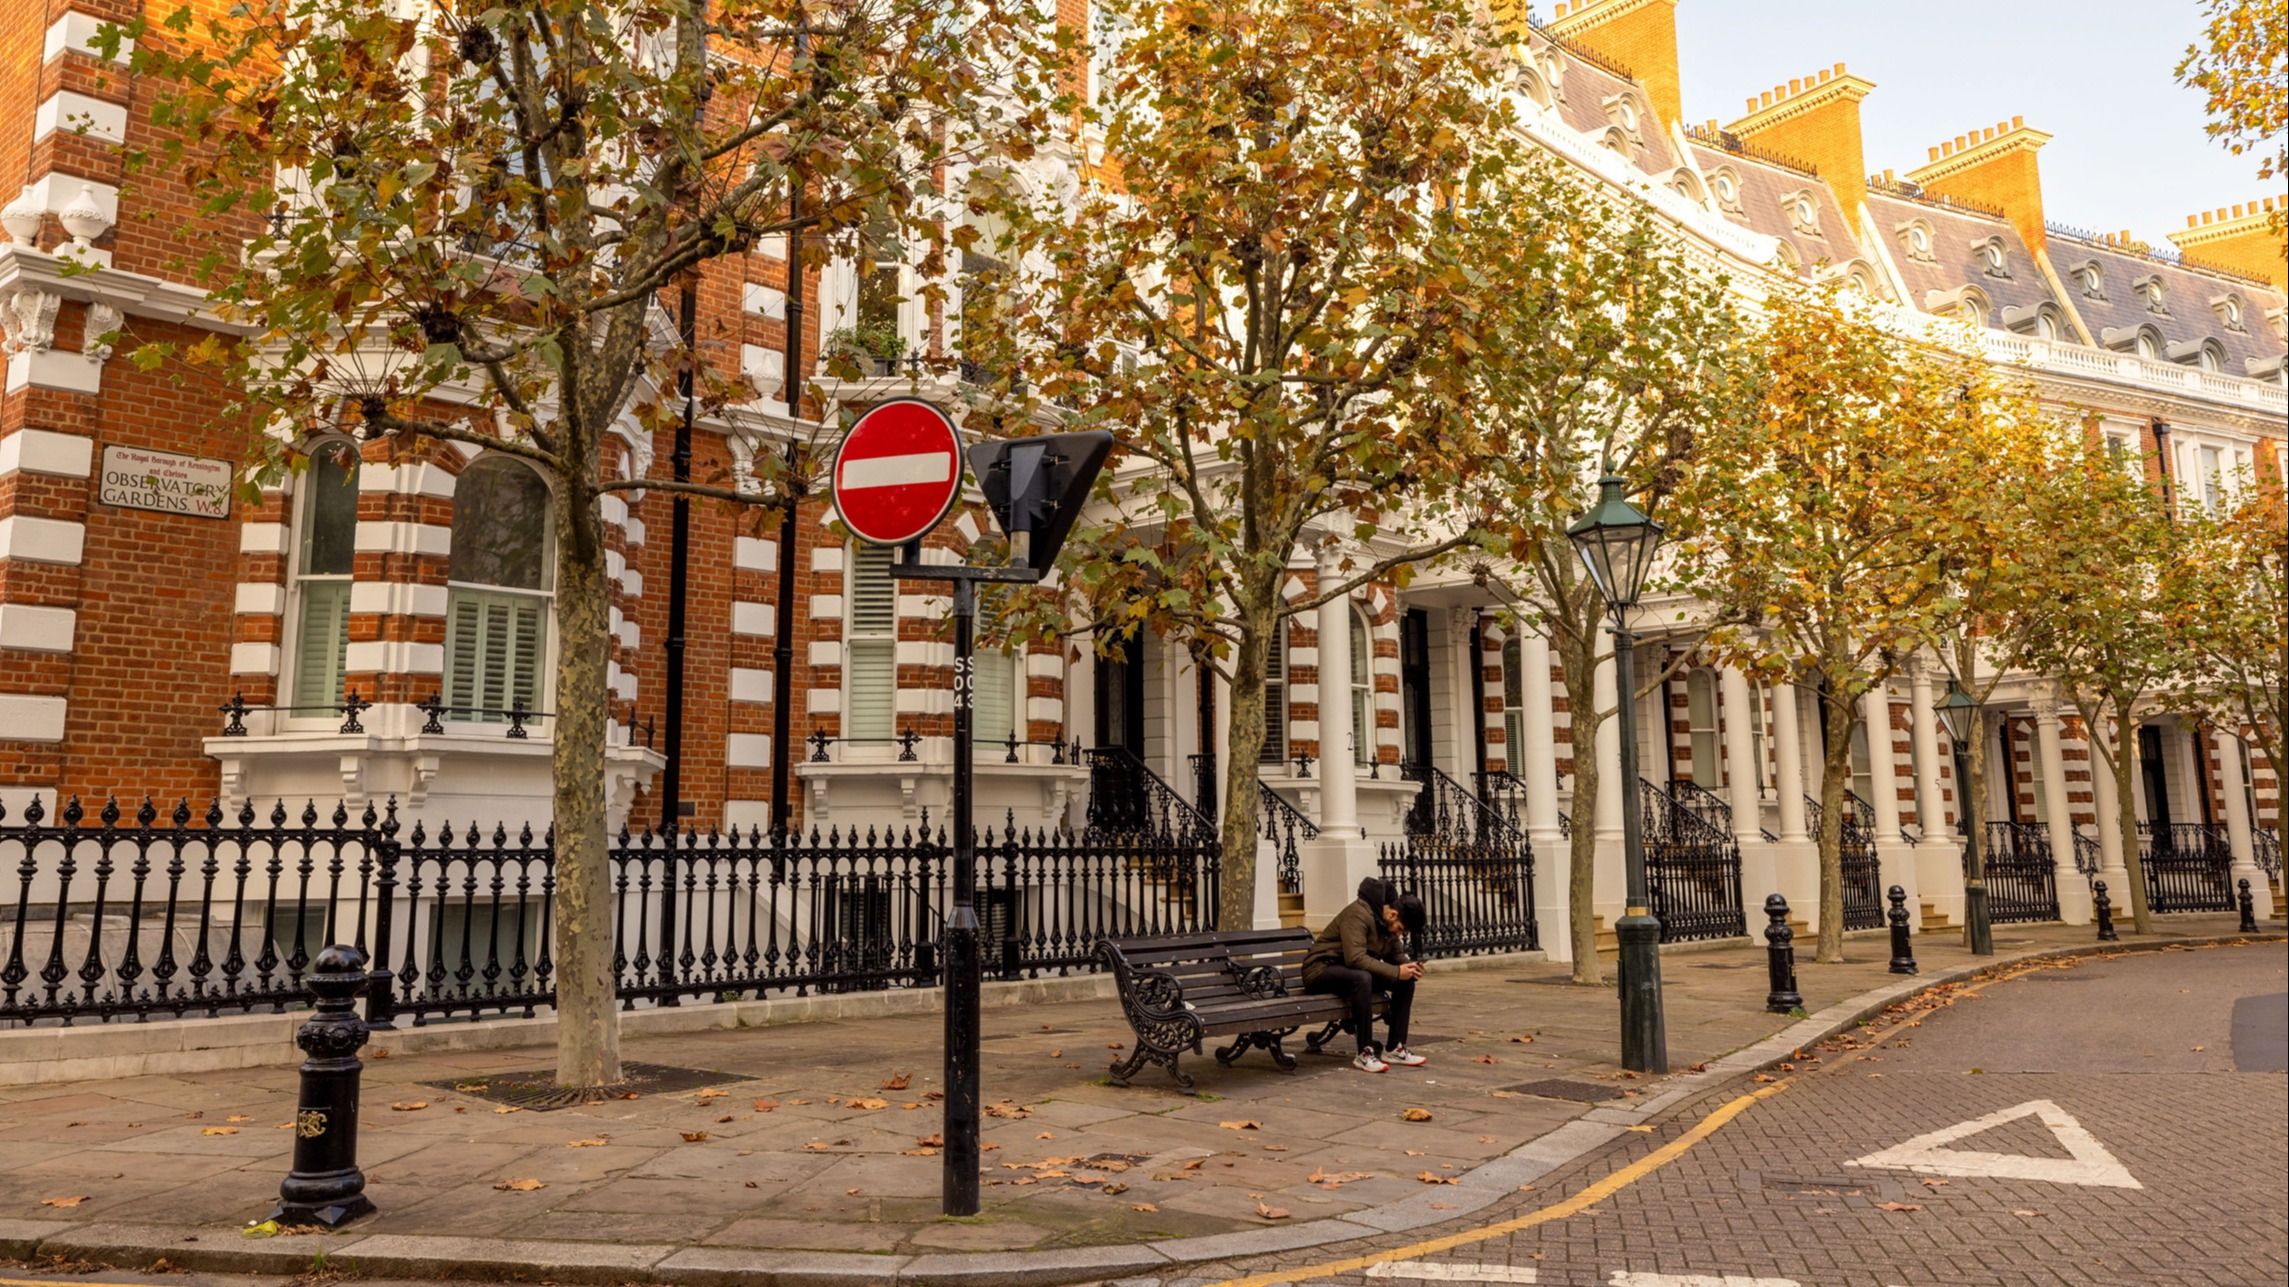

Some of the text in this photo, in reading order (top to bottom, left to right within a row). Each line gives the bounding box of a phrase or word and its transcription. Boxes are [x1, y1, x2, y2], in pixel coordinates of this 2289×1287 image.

[116, 452, 129, 460] The
[131, 453, 149, 464] Royal
[151, 456, 177, 468] Borough
[188, 461, 221, 473] Kensington
[149, 468, 188, 479] and Chelsea
[1346, 731, 1353, 751] 2
[1934, 778, 1941, 791] 5
